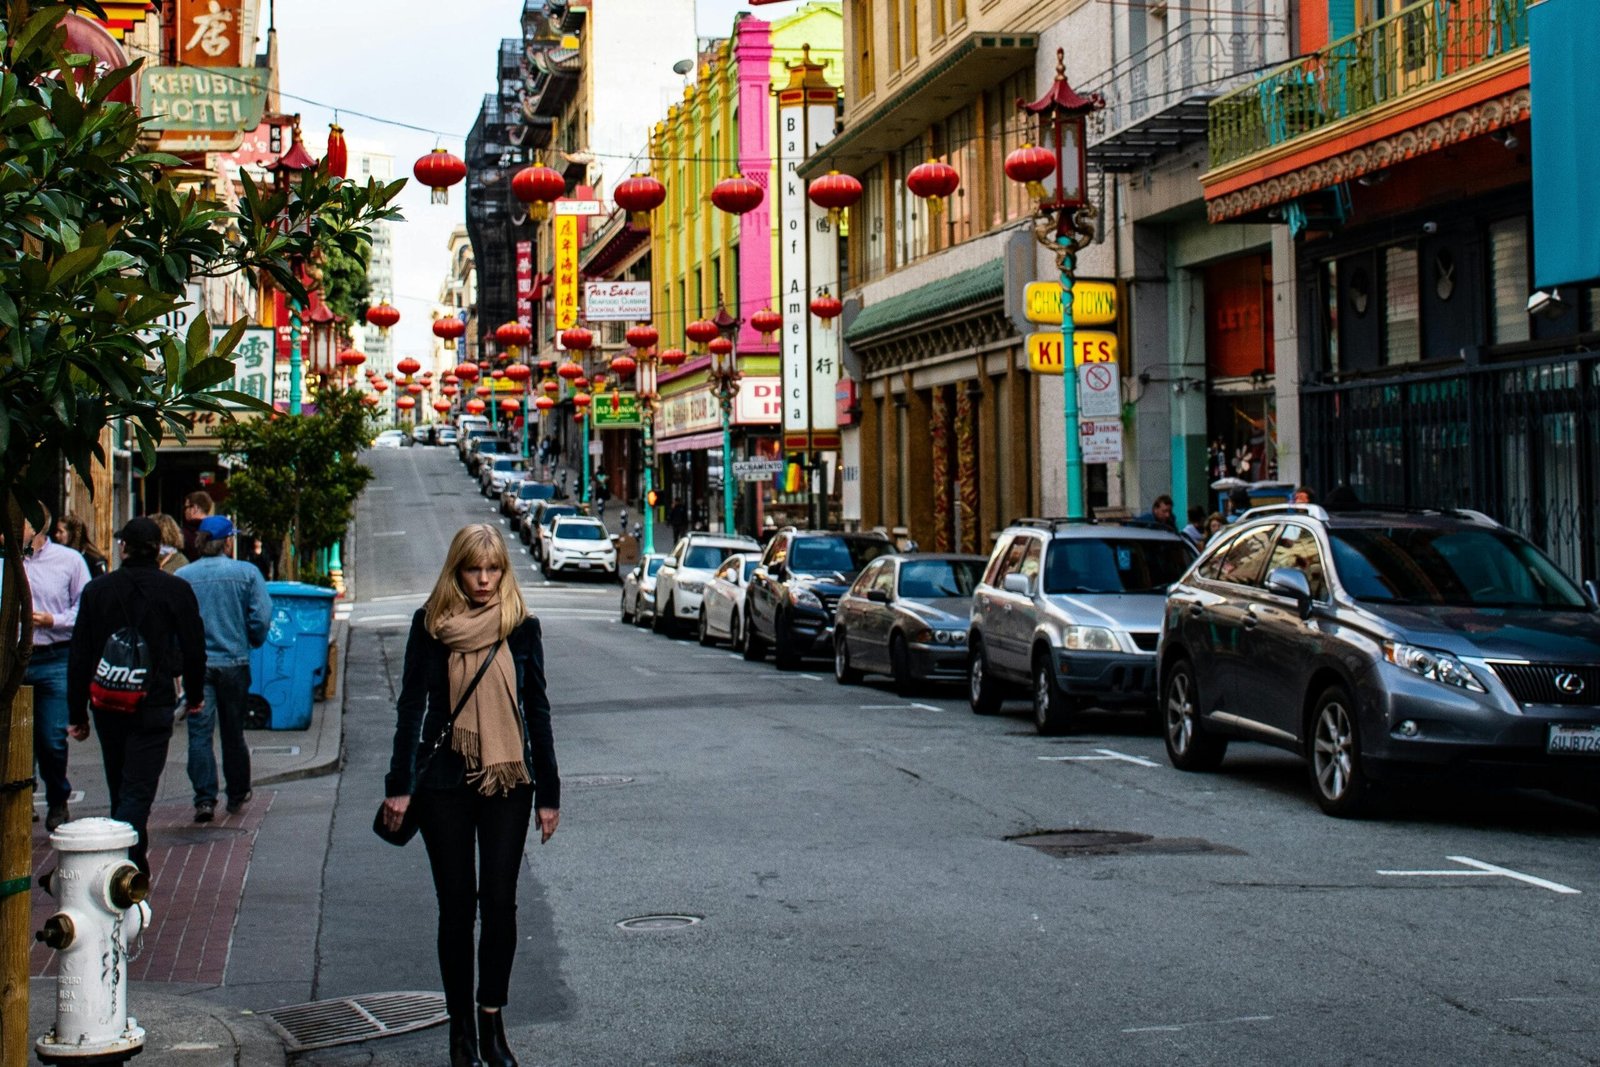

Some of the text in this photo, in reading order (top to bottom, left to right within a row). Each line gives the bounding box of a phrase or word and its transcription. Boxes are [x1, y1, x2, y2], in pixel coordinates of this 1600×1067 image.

[152, 98, 248, 124] HOTEL
[786, 117, 801, 419] Bank of America
[588, 285, 606, 298] Far
[609, 284, 636, 297] East
[1034, 290, 1114, 314] CHIN TOWN
[1039, 341, 1110, 365] KIES
